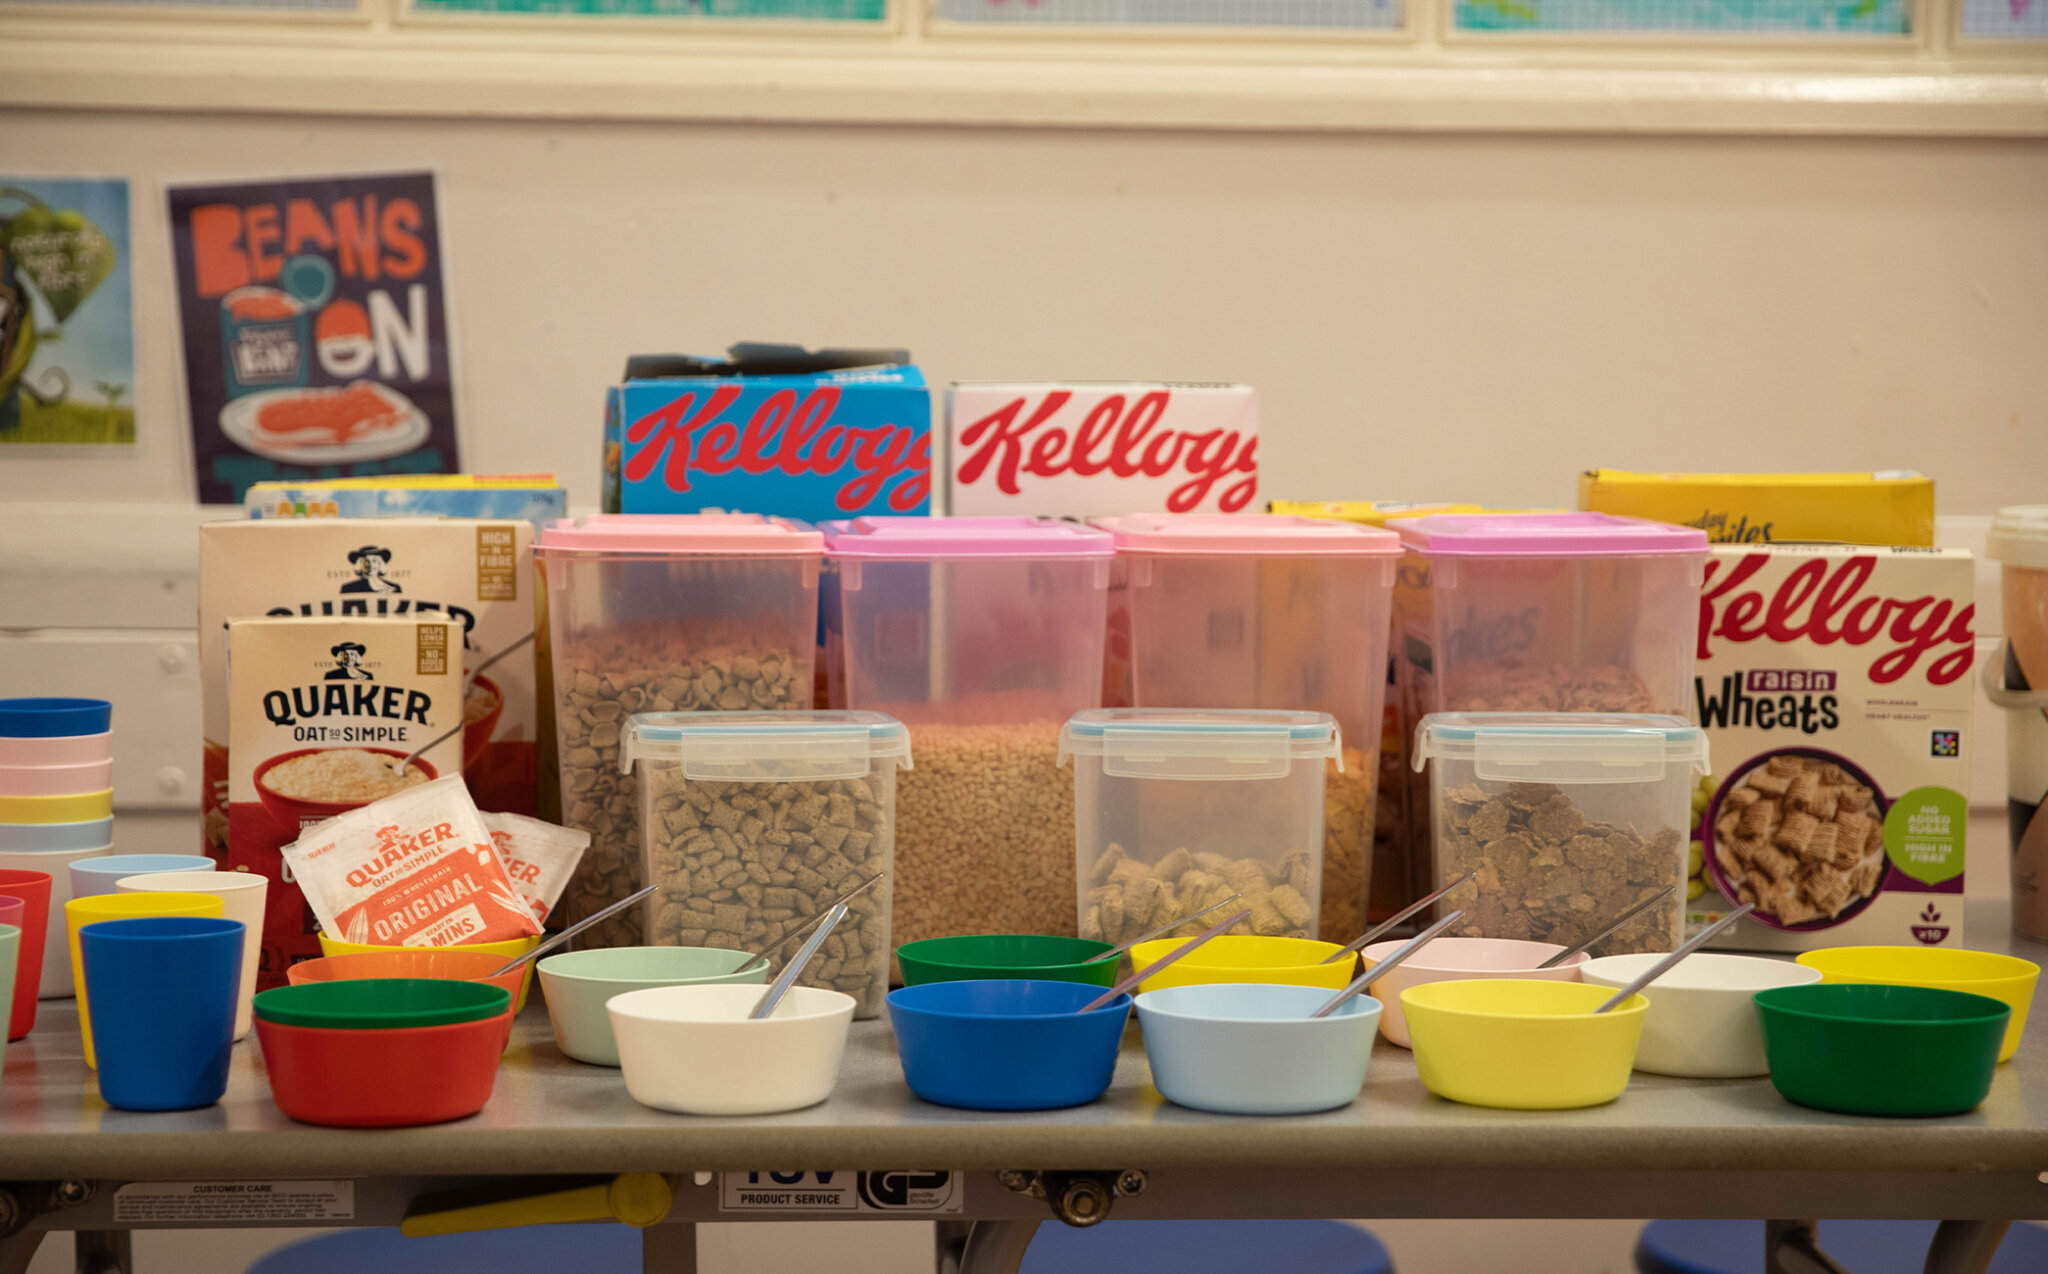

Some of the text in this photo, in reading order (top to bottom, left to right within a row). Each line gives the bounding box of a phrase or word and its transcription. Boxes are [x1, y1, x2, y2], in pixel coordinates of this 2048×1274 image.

[191, 195, 428, 297] BEANS
[315, 284, 430, 382] ON
[482, 531, 511, 545] HIGH
[480, 555, 513, 568] FIBRE
[426, 649, 439, 659] NO
[1753, 671, 1829, 689] raisin
[263, 683, 432, 727] QUAKER
[1695, 671, 1839, 735] Wheats
[294, 726, 328, 742] OAT
[343, 726, 408, 742] SIMPLE
[346, 822, 455, 889] QUAKER
[372, 871, 397, 888] OAT
[403, 844, 447, 872] SIMPLE
[403, 866, 452, 896] WHOLEGRAIN
[373, 872, 484, 942] ORIGINAL
[193, 1184, 273, 1193] CUSTOMER CARE
[741, 1194, 840, 1205] PRODUCT SERVICE
